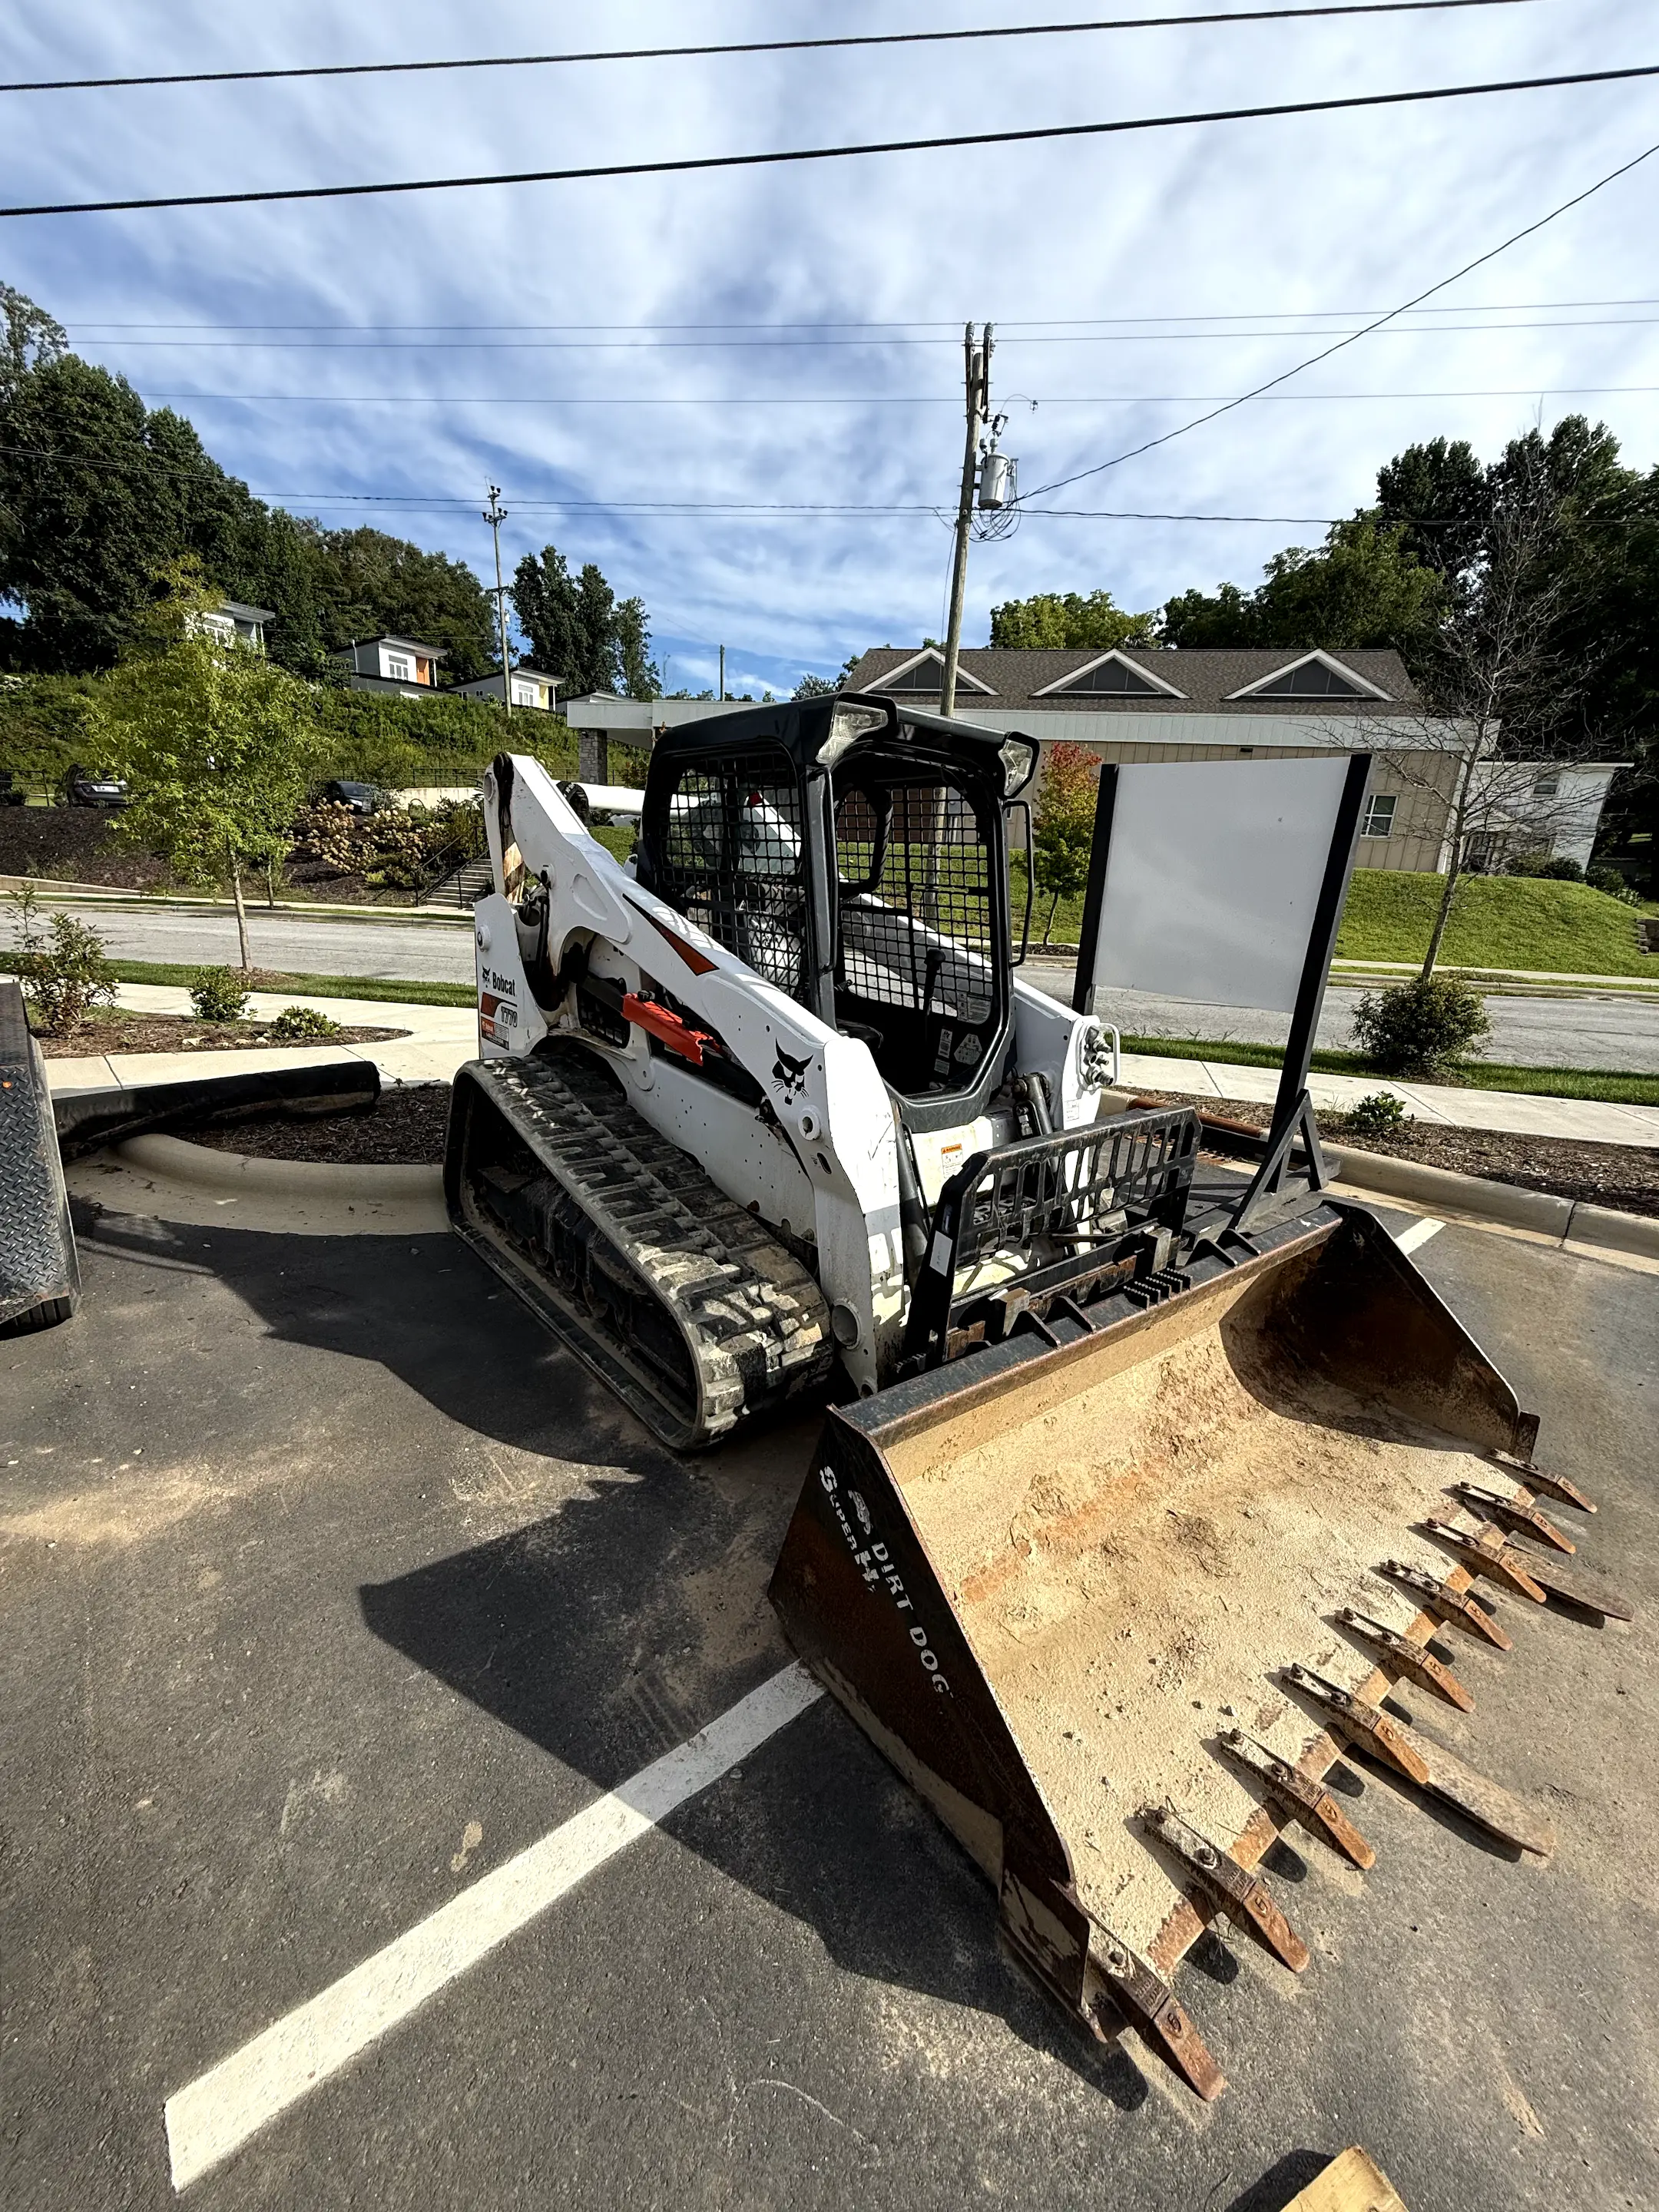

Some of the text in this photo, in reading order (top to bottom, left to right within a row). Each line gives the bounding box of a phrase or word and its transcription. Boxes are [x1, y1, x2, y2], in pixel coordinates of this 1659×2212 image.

[492, 971, 515, 997] Bobcat
[501, 1005, 518, 1028] T770
[871, 1541, 951, 1694] DIRT DOG
